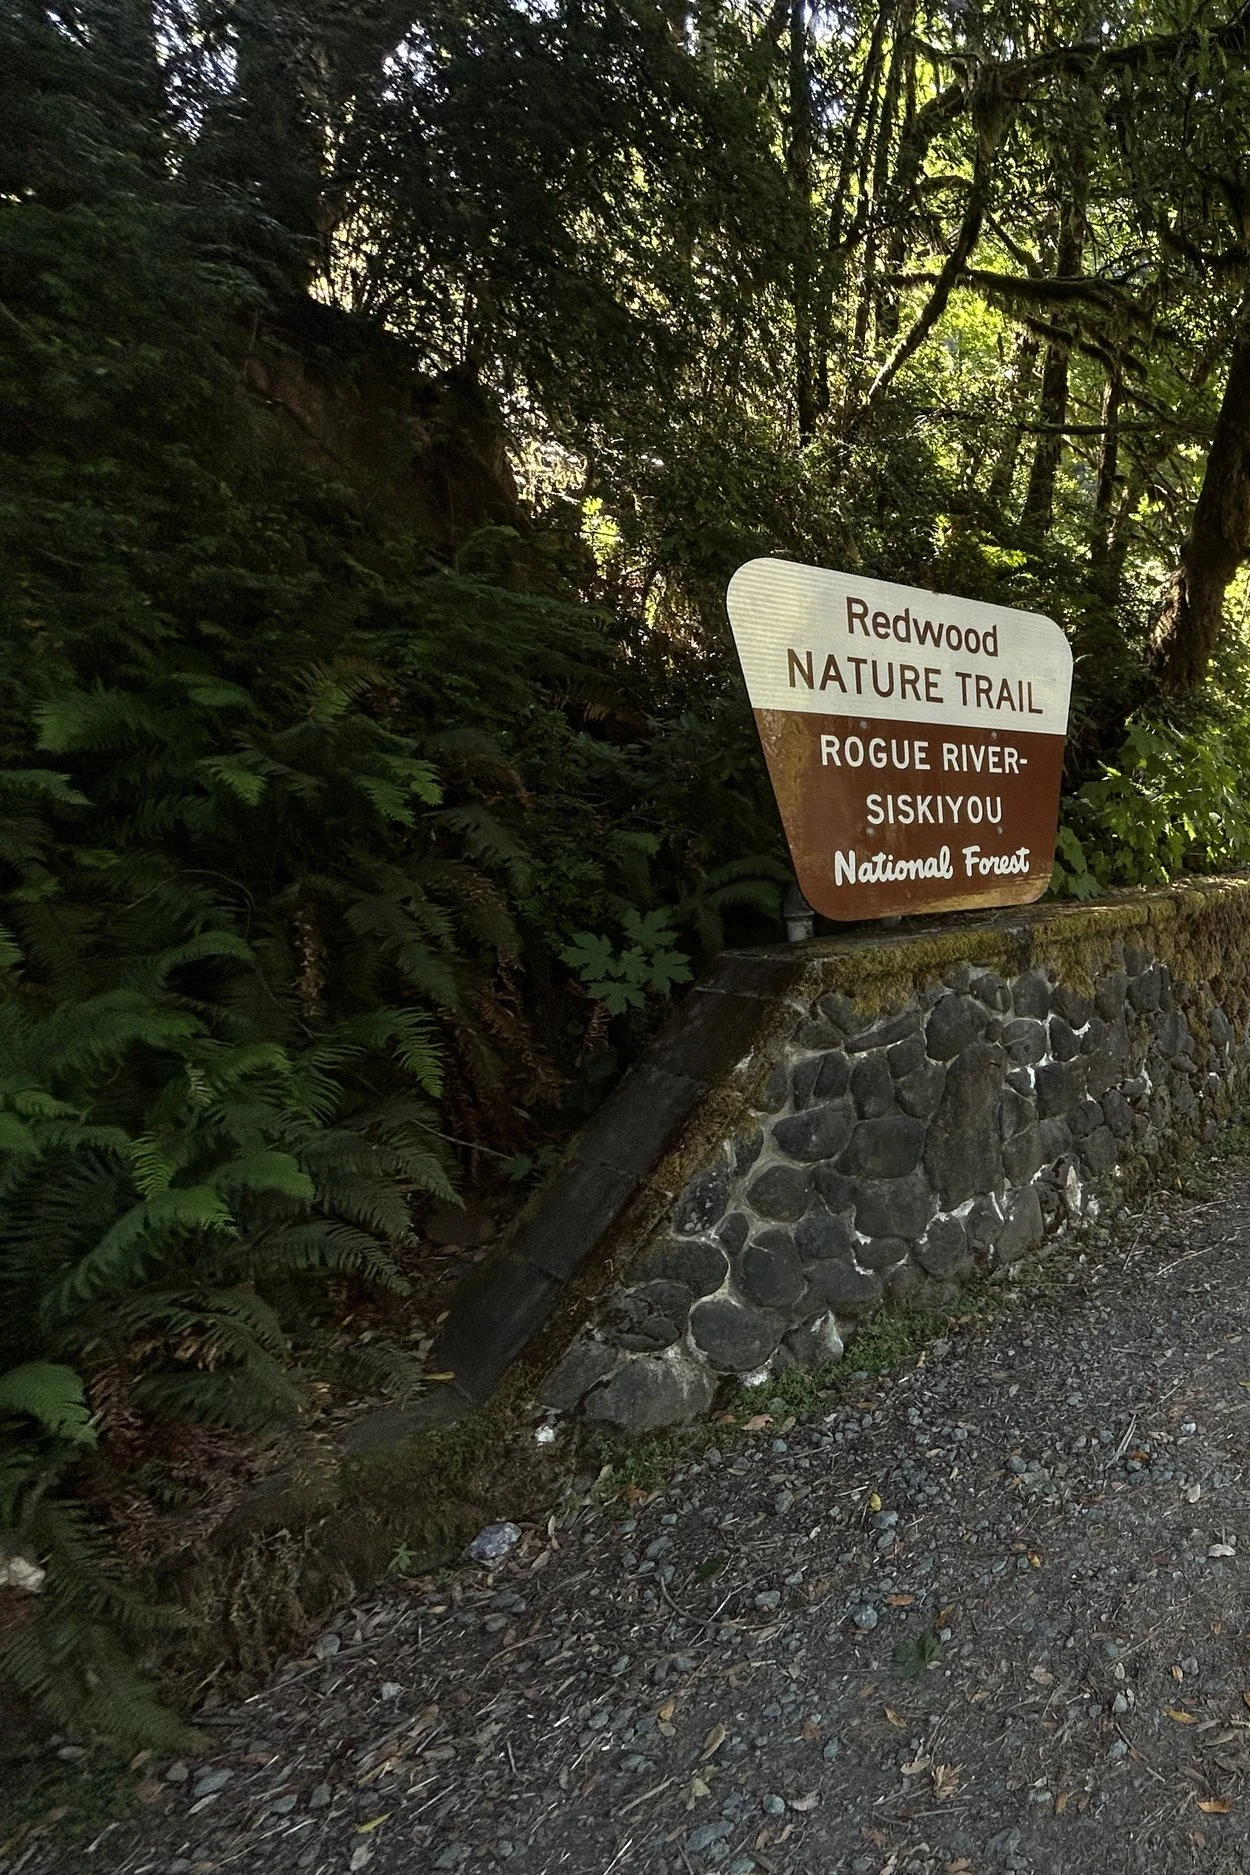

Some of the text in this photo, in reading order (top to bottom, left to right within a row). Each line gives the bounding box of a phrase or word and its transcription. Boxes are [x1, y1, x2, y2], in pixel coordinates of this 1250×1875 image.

[846, 597, 999, 658] Redwood
[787, 648, 1044, 715] NATURE TRAIL
[820, 734, 1028, 774] ROGUE RIVER-
[865, 793, 1003, 825] SISKIYOU
[834, 845, 1031, 886] National Forest
